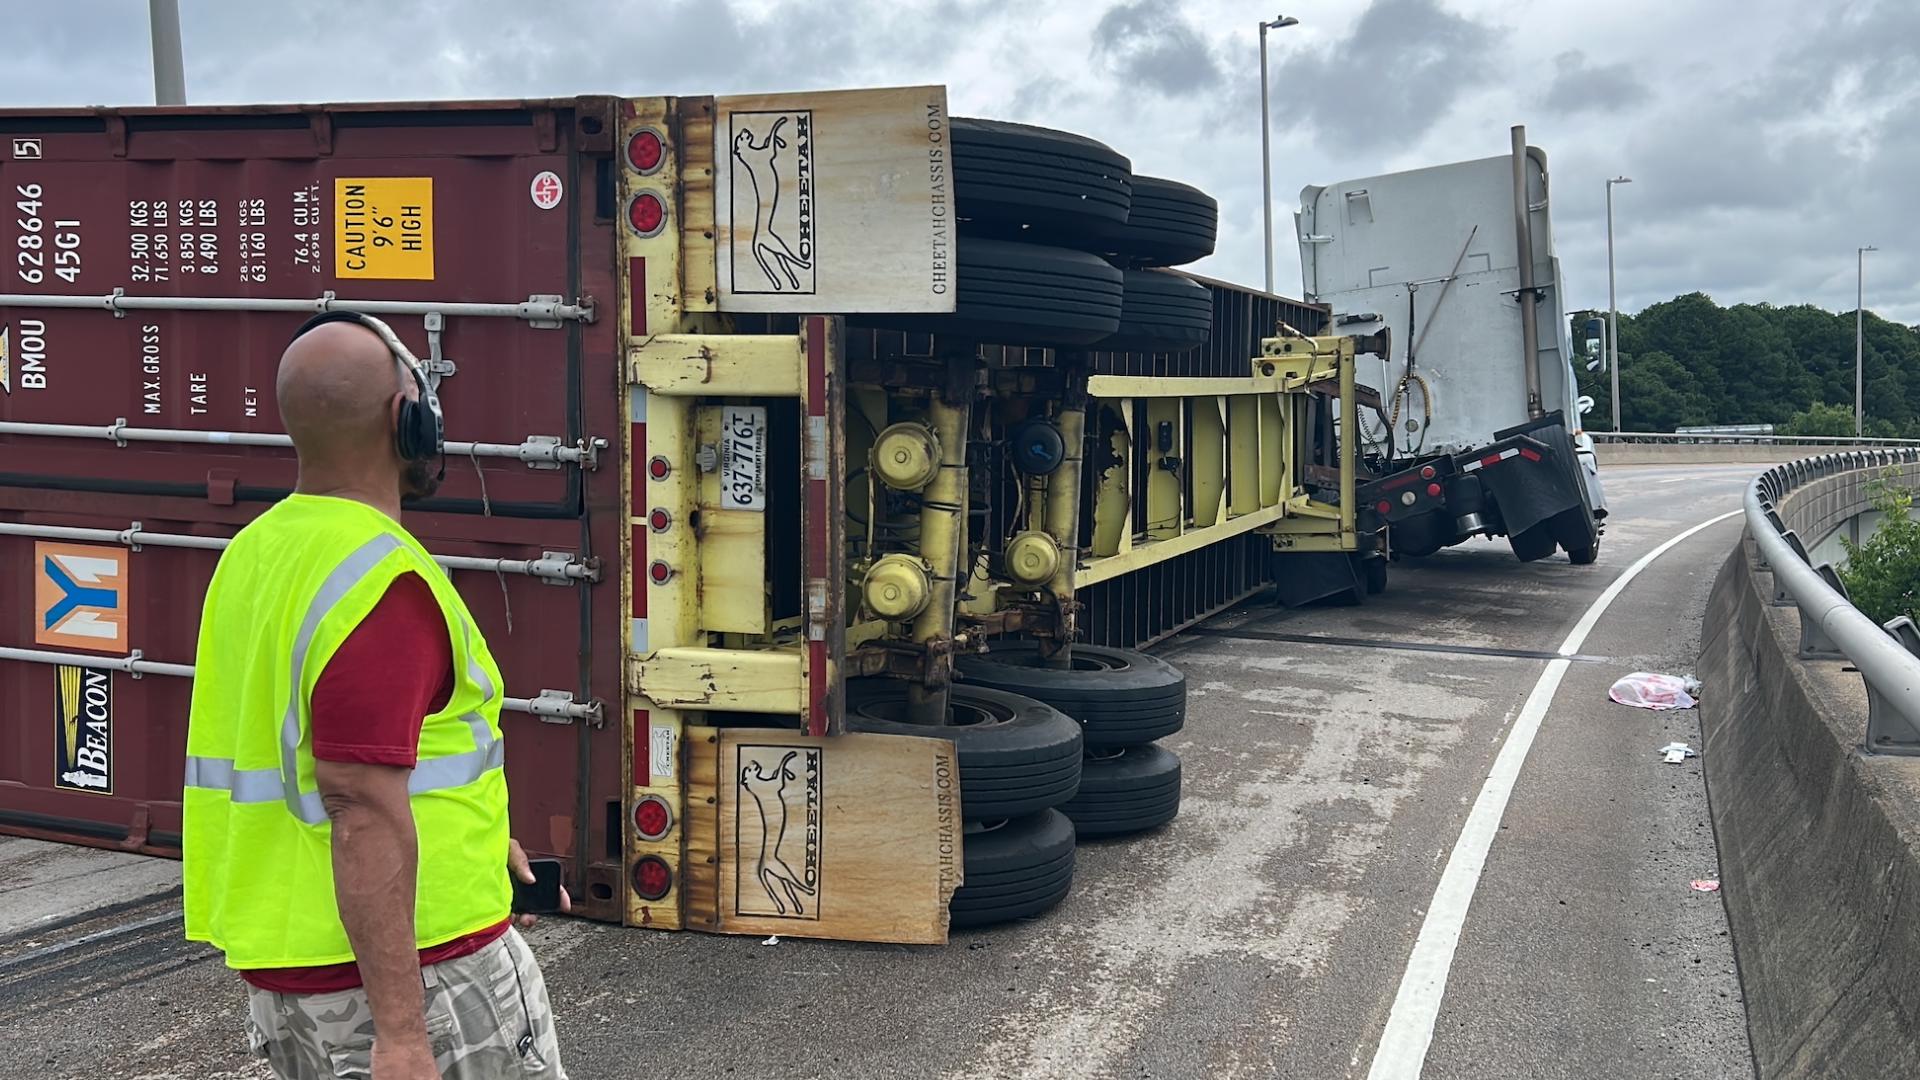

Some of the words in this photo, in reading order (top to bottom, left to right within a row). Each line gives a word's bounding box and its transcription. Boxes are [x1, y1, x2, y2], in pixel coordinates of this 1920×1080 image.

[15, 141, 41, 157] 5
[293, 186, 308, 226] CU.M.
[311, 180, 320, 225] CU.FT.
[797, 115, 811, 260] CHEETAH
[926, 103, 947, 295] CHEETAHCHASSIS.COM
[17, 183, 44, 284] 628646
[130, 200, 149, 227] KGS
[153, 200, 168, 227] LBS
[179, 199, 194, 227] KGS
[199, 199, 217, 227] LBS
[239, 200, 248, 226] KGS
[250, 198, 265, 226] LBS
[345, 184, 366, 271] CAUTION
[401, 205, 422, 251] HIGH
[55, 219, 81, 283] 45G1
[294, 233, 309, 264] 76.4
[20, 319, 46, 389] BMOU
[143, 324, 161, 414] MAX.GROSS
[190, 373, 207, 415] TARE
[245, 386, 257, 417] NET
[77, 668, 108, 775] BEACON
[805, 751, 818, 887] CHEETAH
